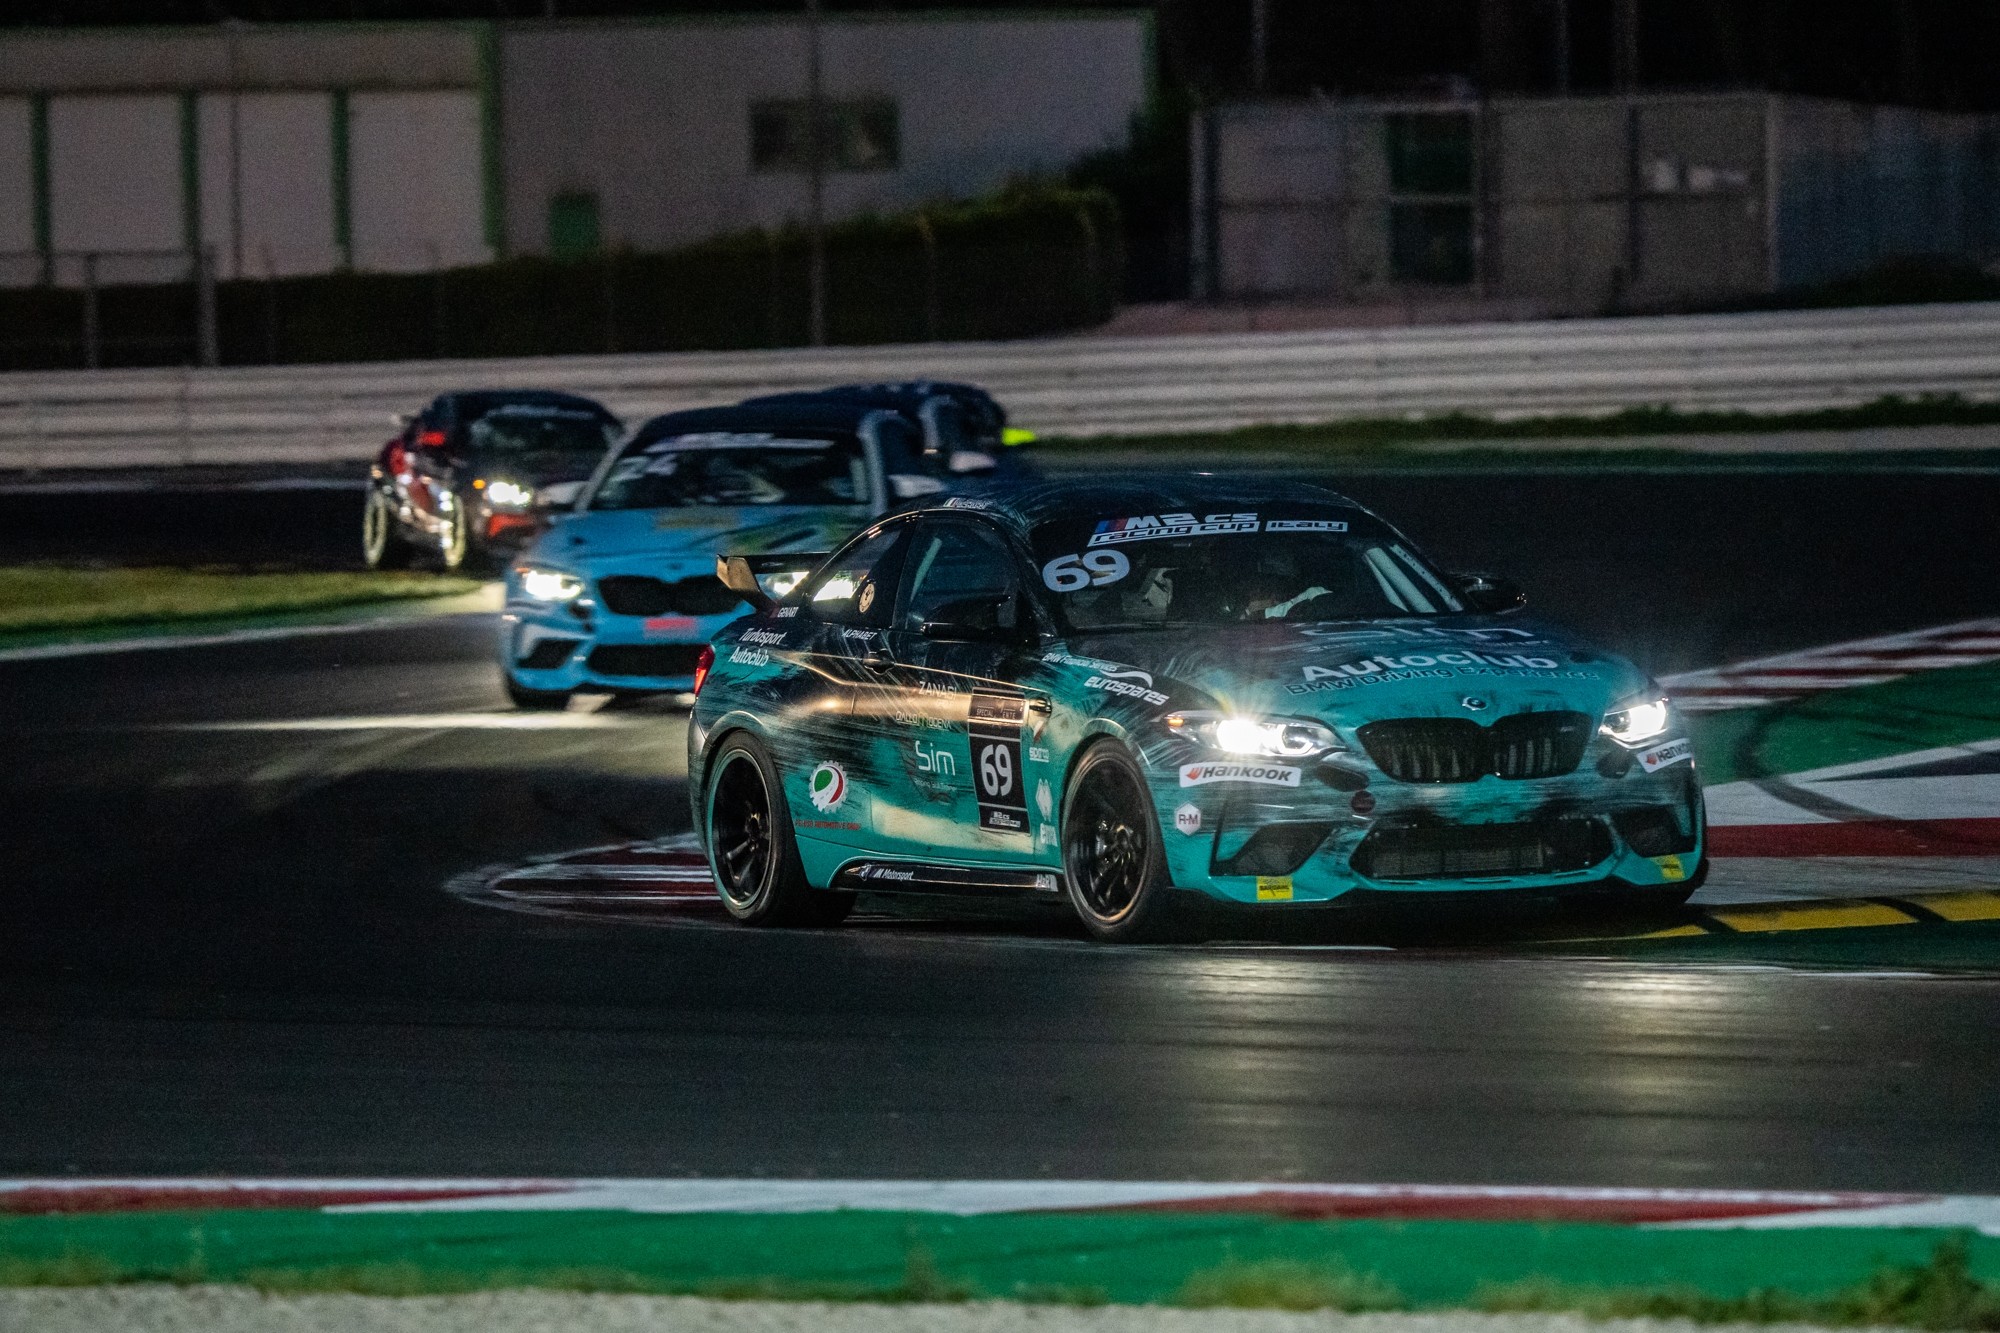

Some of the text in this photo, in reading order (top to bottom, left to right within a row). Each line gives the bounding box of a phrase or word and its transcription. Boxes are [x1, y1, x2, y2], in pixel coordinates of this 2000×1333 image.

[1199, 521, 1257, 534] cup
[1042, 549, 1130, 592] 69
[739, 627, 788, 647] Turbosport
[842, 629, 877, 641] ALPHABET
[728, 646, 770, 667] Autoclub
[1302, 650, 1558, 682] Autoclub
[1084, 675, 1170, 706] eurospares
[1284, 676, 1355, 695] BMW
[1358, 667, 1454, 685] Driving
[915, 741, 956, 776] Sim
[980, 744, 1013, 797] 69
[1178, 814, 1199, 825] R-M
[883, 868, 914, 881] Motorsport
